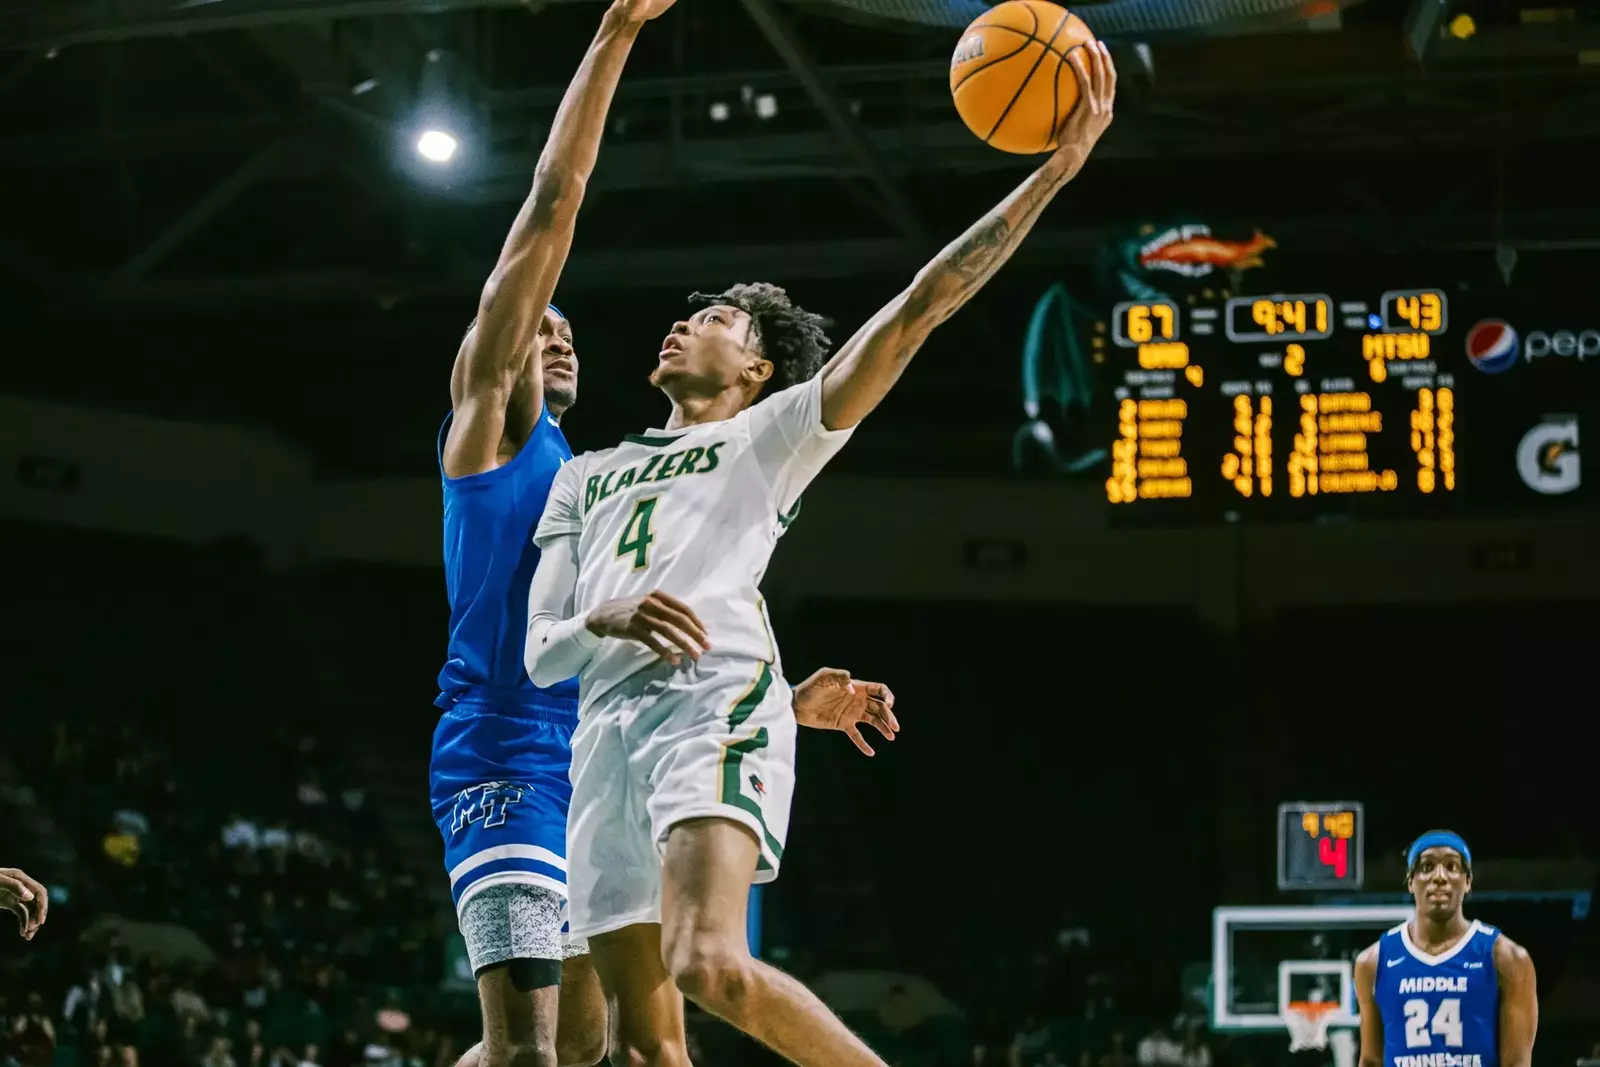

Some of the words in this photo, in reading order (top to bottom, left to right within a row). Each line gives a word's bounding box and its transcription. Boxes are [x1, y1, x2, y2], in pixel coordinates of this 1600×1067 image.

[1128, 304, 1174, 342] 67
[1252, 299, 1327, 335] 9:41
[1397, 293, 1441, 331] 43
[584, 441, 727, 516] BLAZERS
[1516, 418, 1581, 495] G
[614, 494, 662, 574] 4
[451, 782, 522, 835] MT
[1319, 836, 1347, 878] 4
[1399, 976, 1468, 994] MIDDLE
[1403, 998, 1463, 1049] 24
